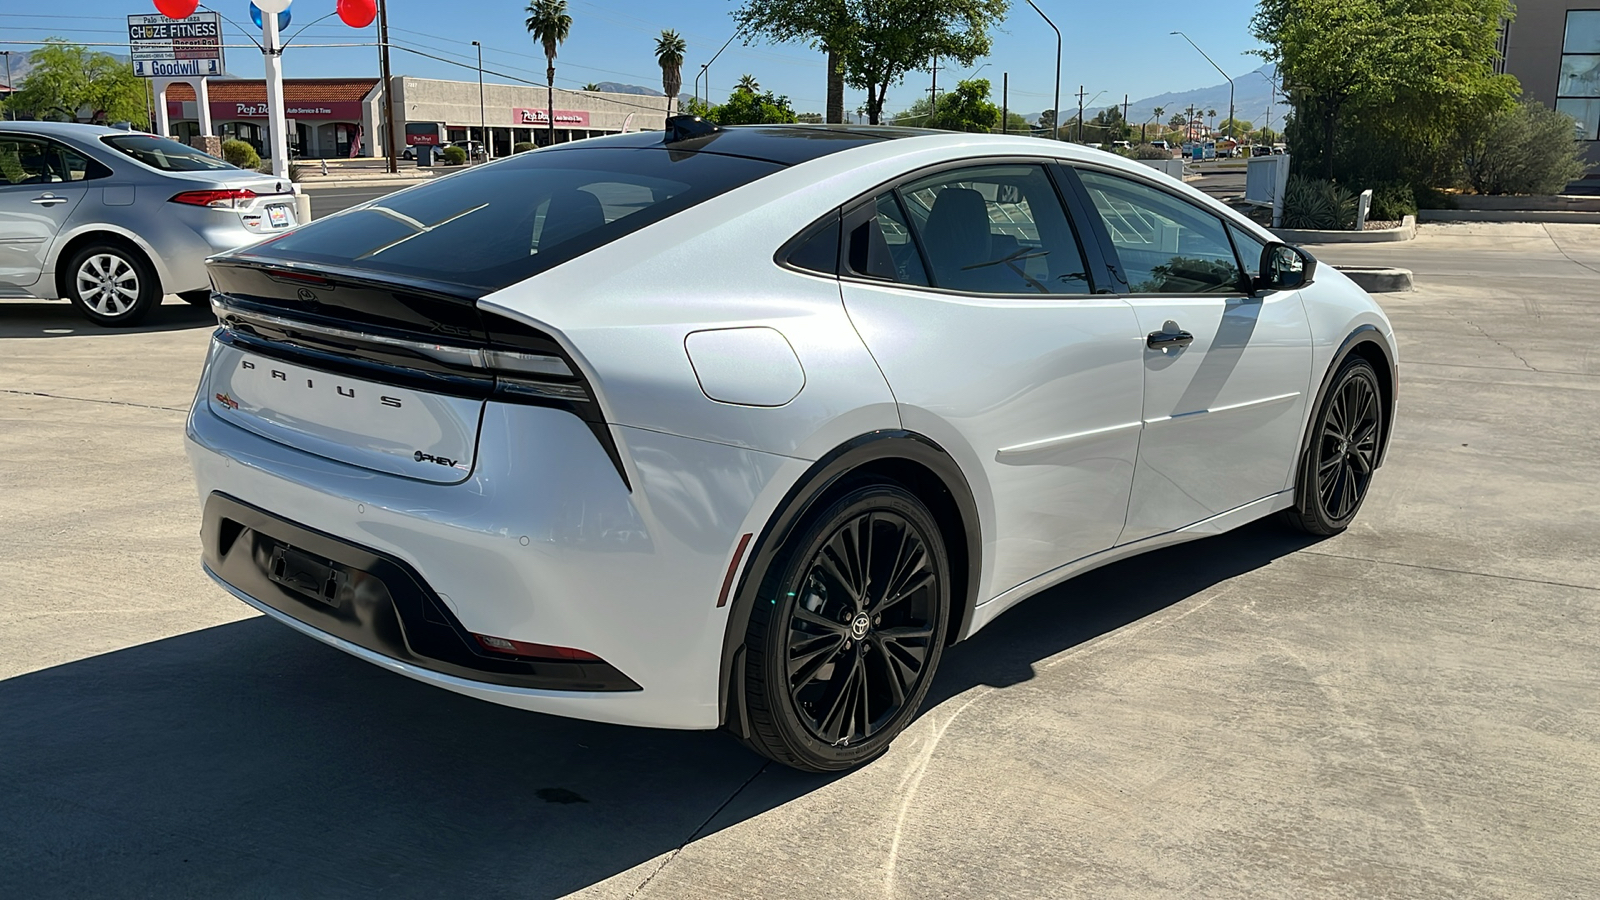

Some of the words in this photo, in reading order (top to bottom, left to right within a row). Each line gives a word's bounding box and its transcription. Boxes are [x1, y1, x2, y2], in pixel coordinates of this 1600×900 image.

[170, 23, 216, 37] FITNESS
[151, 60, 200, 75] Goodwill
[236, 103, 256, 116] Pep
[257, 103, 269, 114] Bo
[430, 320, 470, 336] XSE
[242, 360, 402, 408] PRIUS
[421, 453, 458, 467] PHEV
